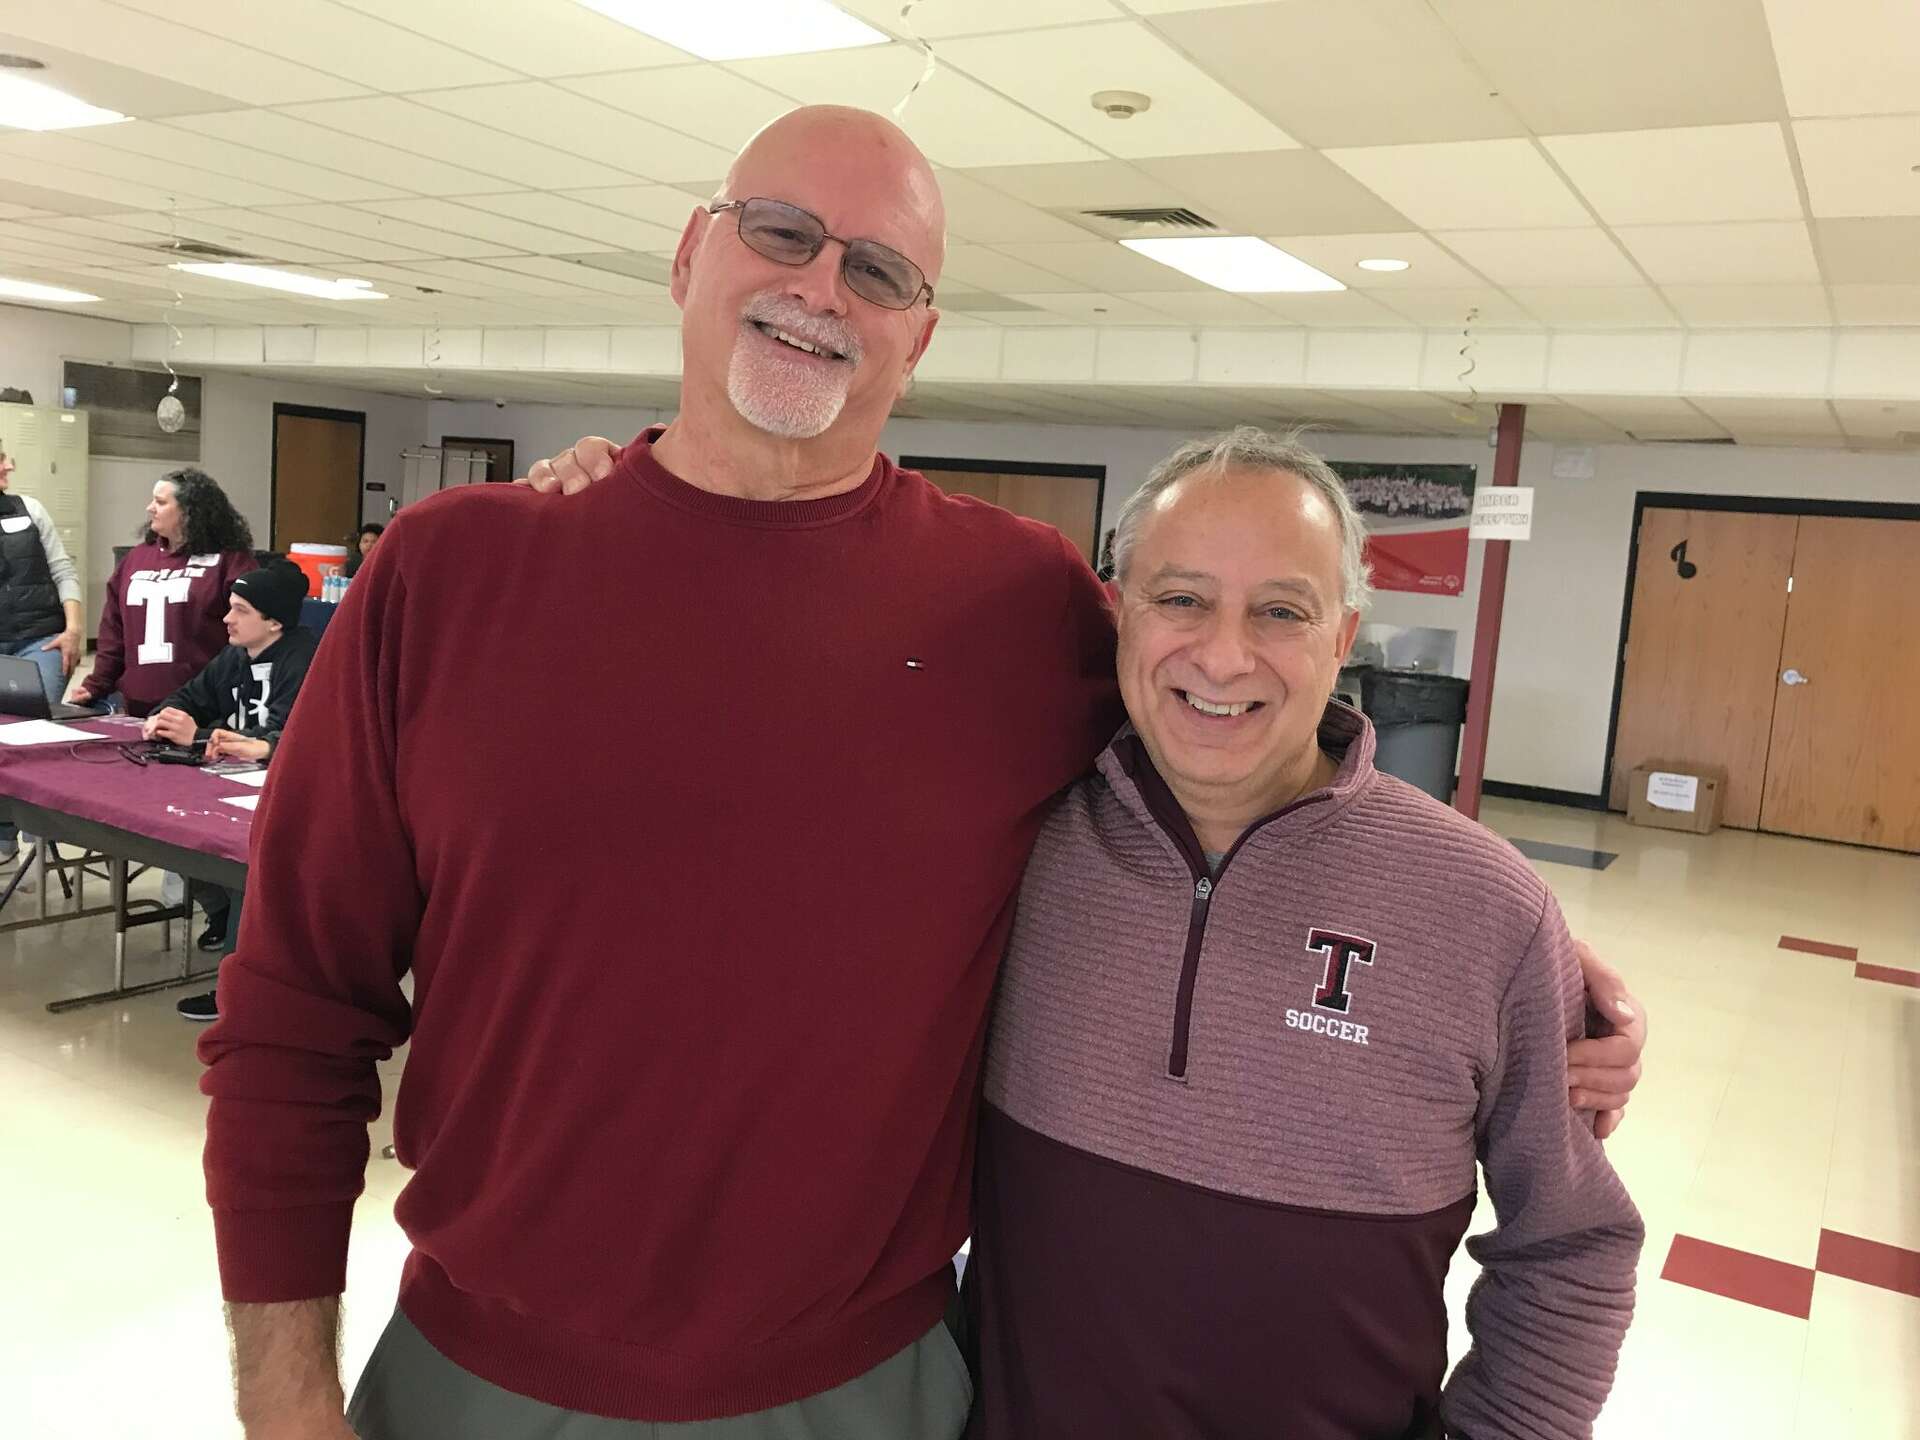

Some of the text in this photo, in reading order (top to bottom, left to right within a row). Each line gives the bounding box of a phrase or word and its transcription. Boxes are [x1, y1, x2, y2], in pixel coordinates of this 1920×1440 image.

[126, 577, 192, 666] T
[1305, 926, 1377, 1015] T
[1285, 1008, 1369, 1045] SOCCER
